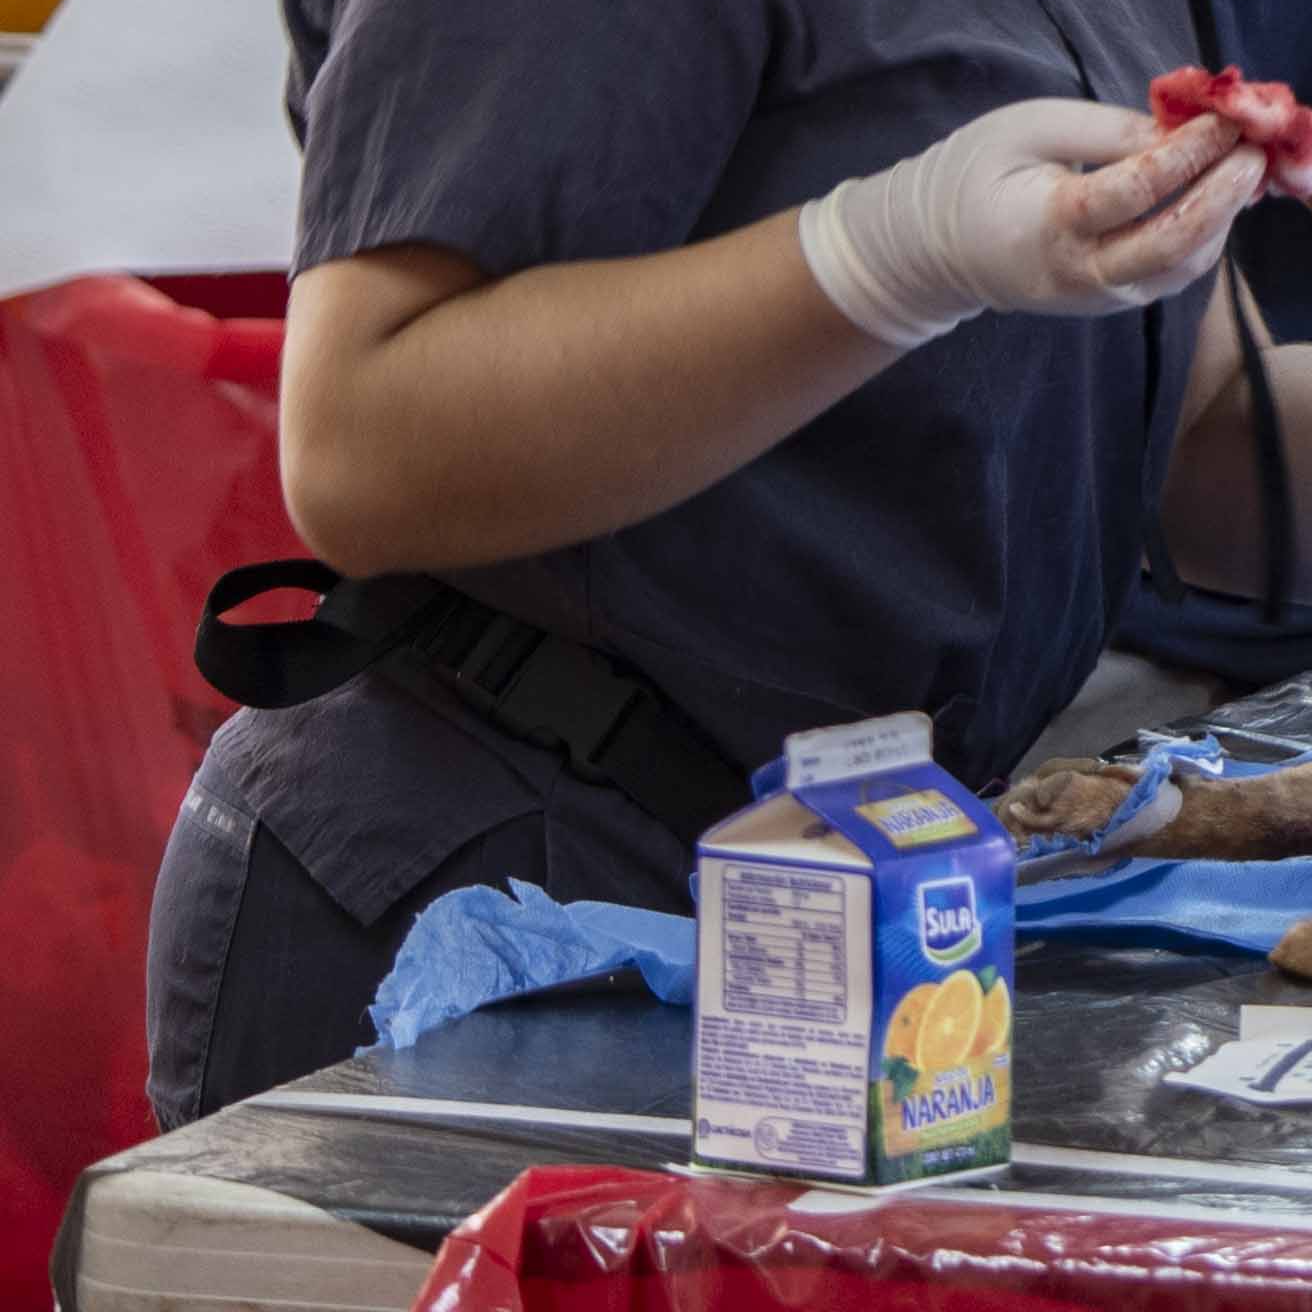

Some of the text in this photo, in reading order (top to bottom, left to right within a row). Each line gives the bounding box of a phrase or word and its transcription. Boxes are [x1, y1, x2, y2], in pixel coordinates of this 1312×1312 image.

[878, 799, 962, 833] NARANJA
[926, 904, 972, 937] SULA
[901, 1073, 995, 1131] NARANJA
